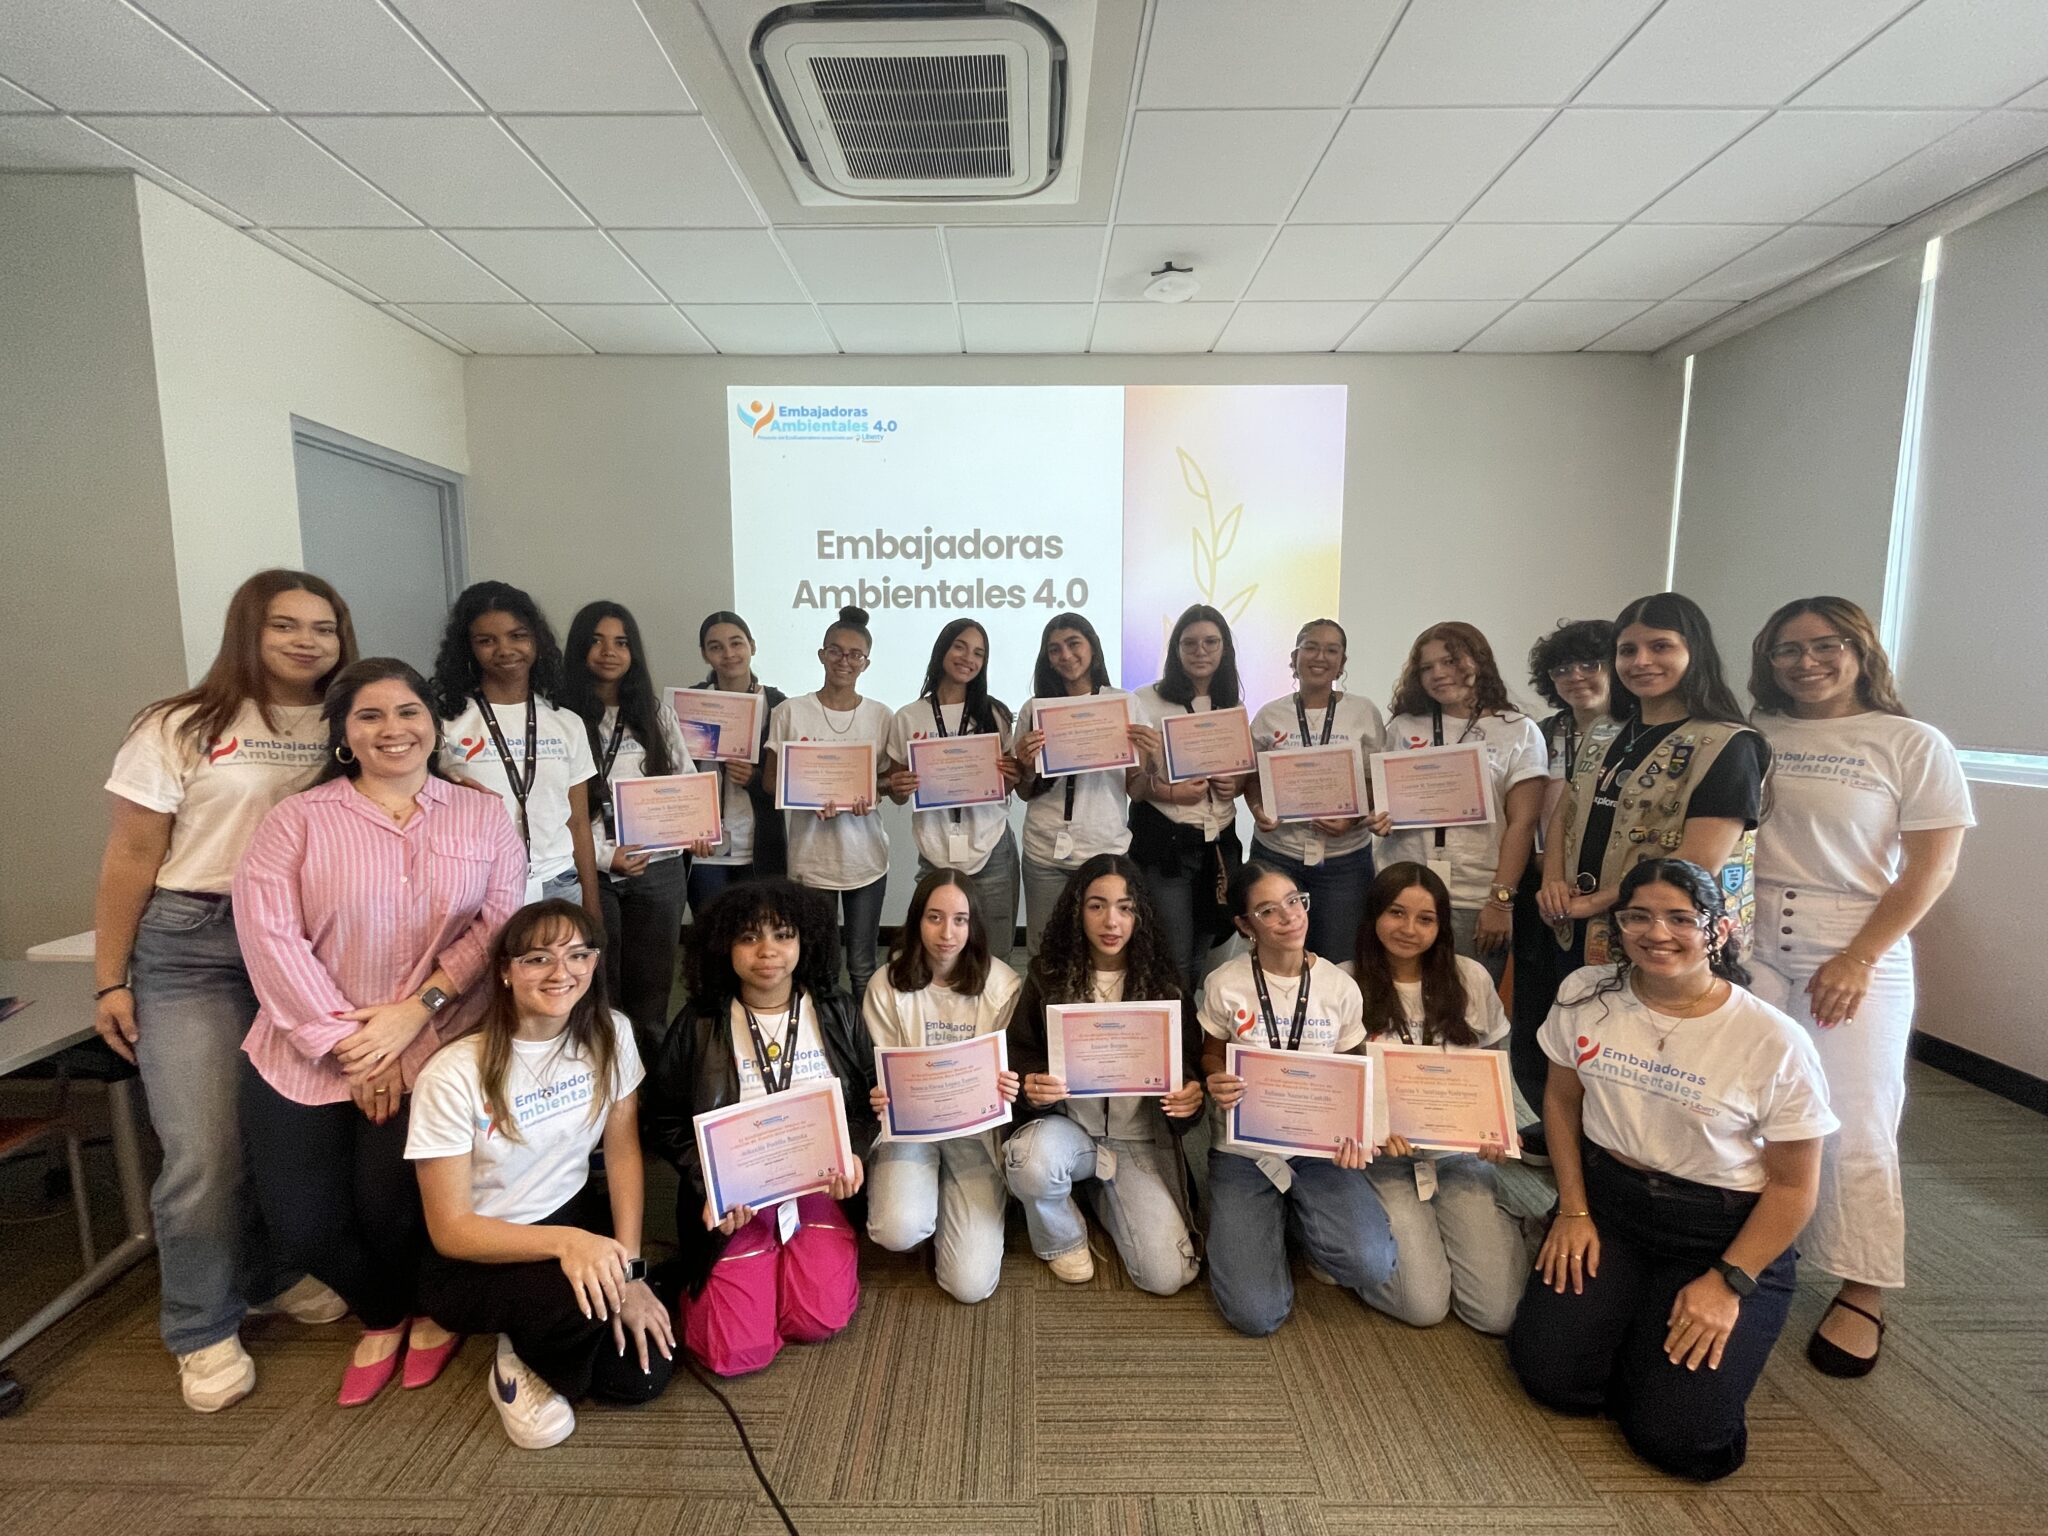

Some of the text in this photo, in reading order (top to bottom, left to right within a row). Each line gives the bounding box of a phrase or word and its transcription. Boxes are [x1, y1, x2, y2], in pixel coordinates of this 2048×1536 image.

[778, 406, 868, 419] Embajadoras
[770, 420, 897, 432] Ambientales 4.0
[816, 526, 1064, 570] Embajadoras
[792, 576, 1089, 609] Ambientales 4.0
[243, 739, 328, 751] Embajado
[488, 738, 562, 746] Ebajoras
[1776, 762, 1861, 778] bientales
[926, 1020, 976, 1032] Embajador
[1258, 1014, 1331, 1026] Ebajoras
[1602, 1047, 1707, 1086] Embajadoras
[1589, 1058, 1703, 1101] Ambientales
[515, 1071, 597, 1108] Embajadora
[519, 1085, 592, 1122] mbiental
